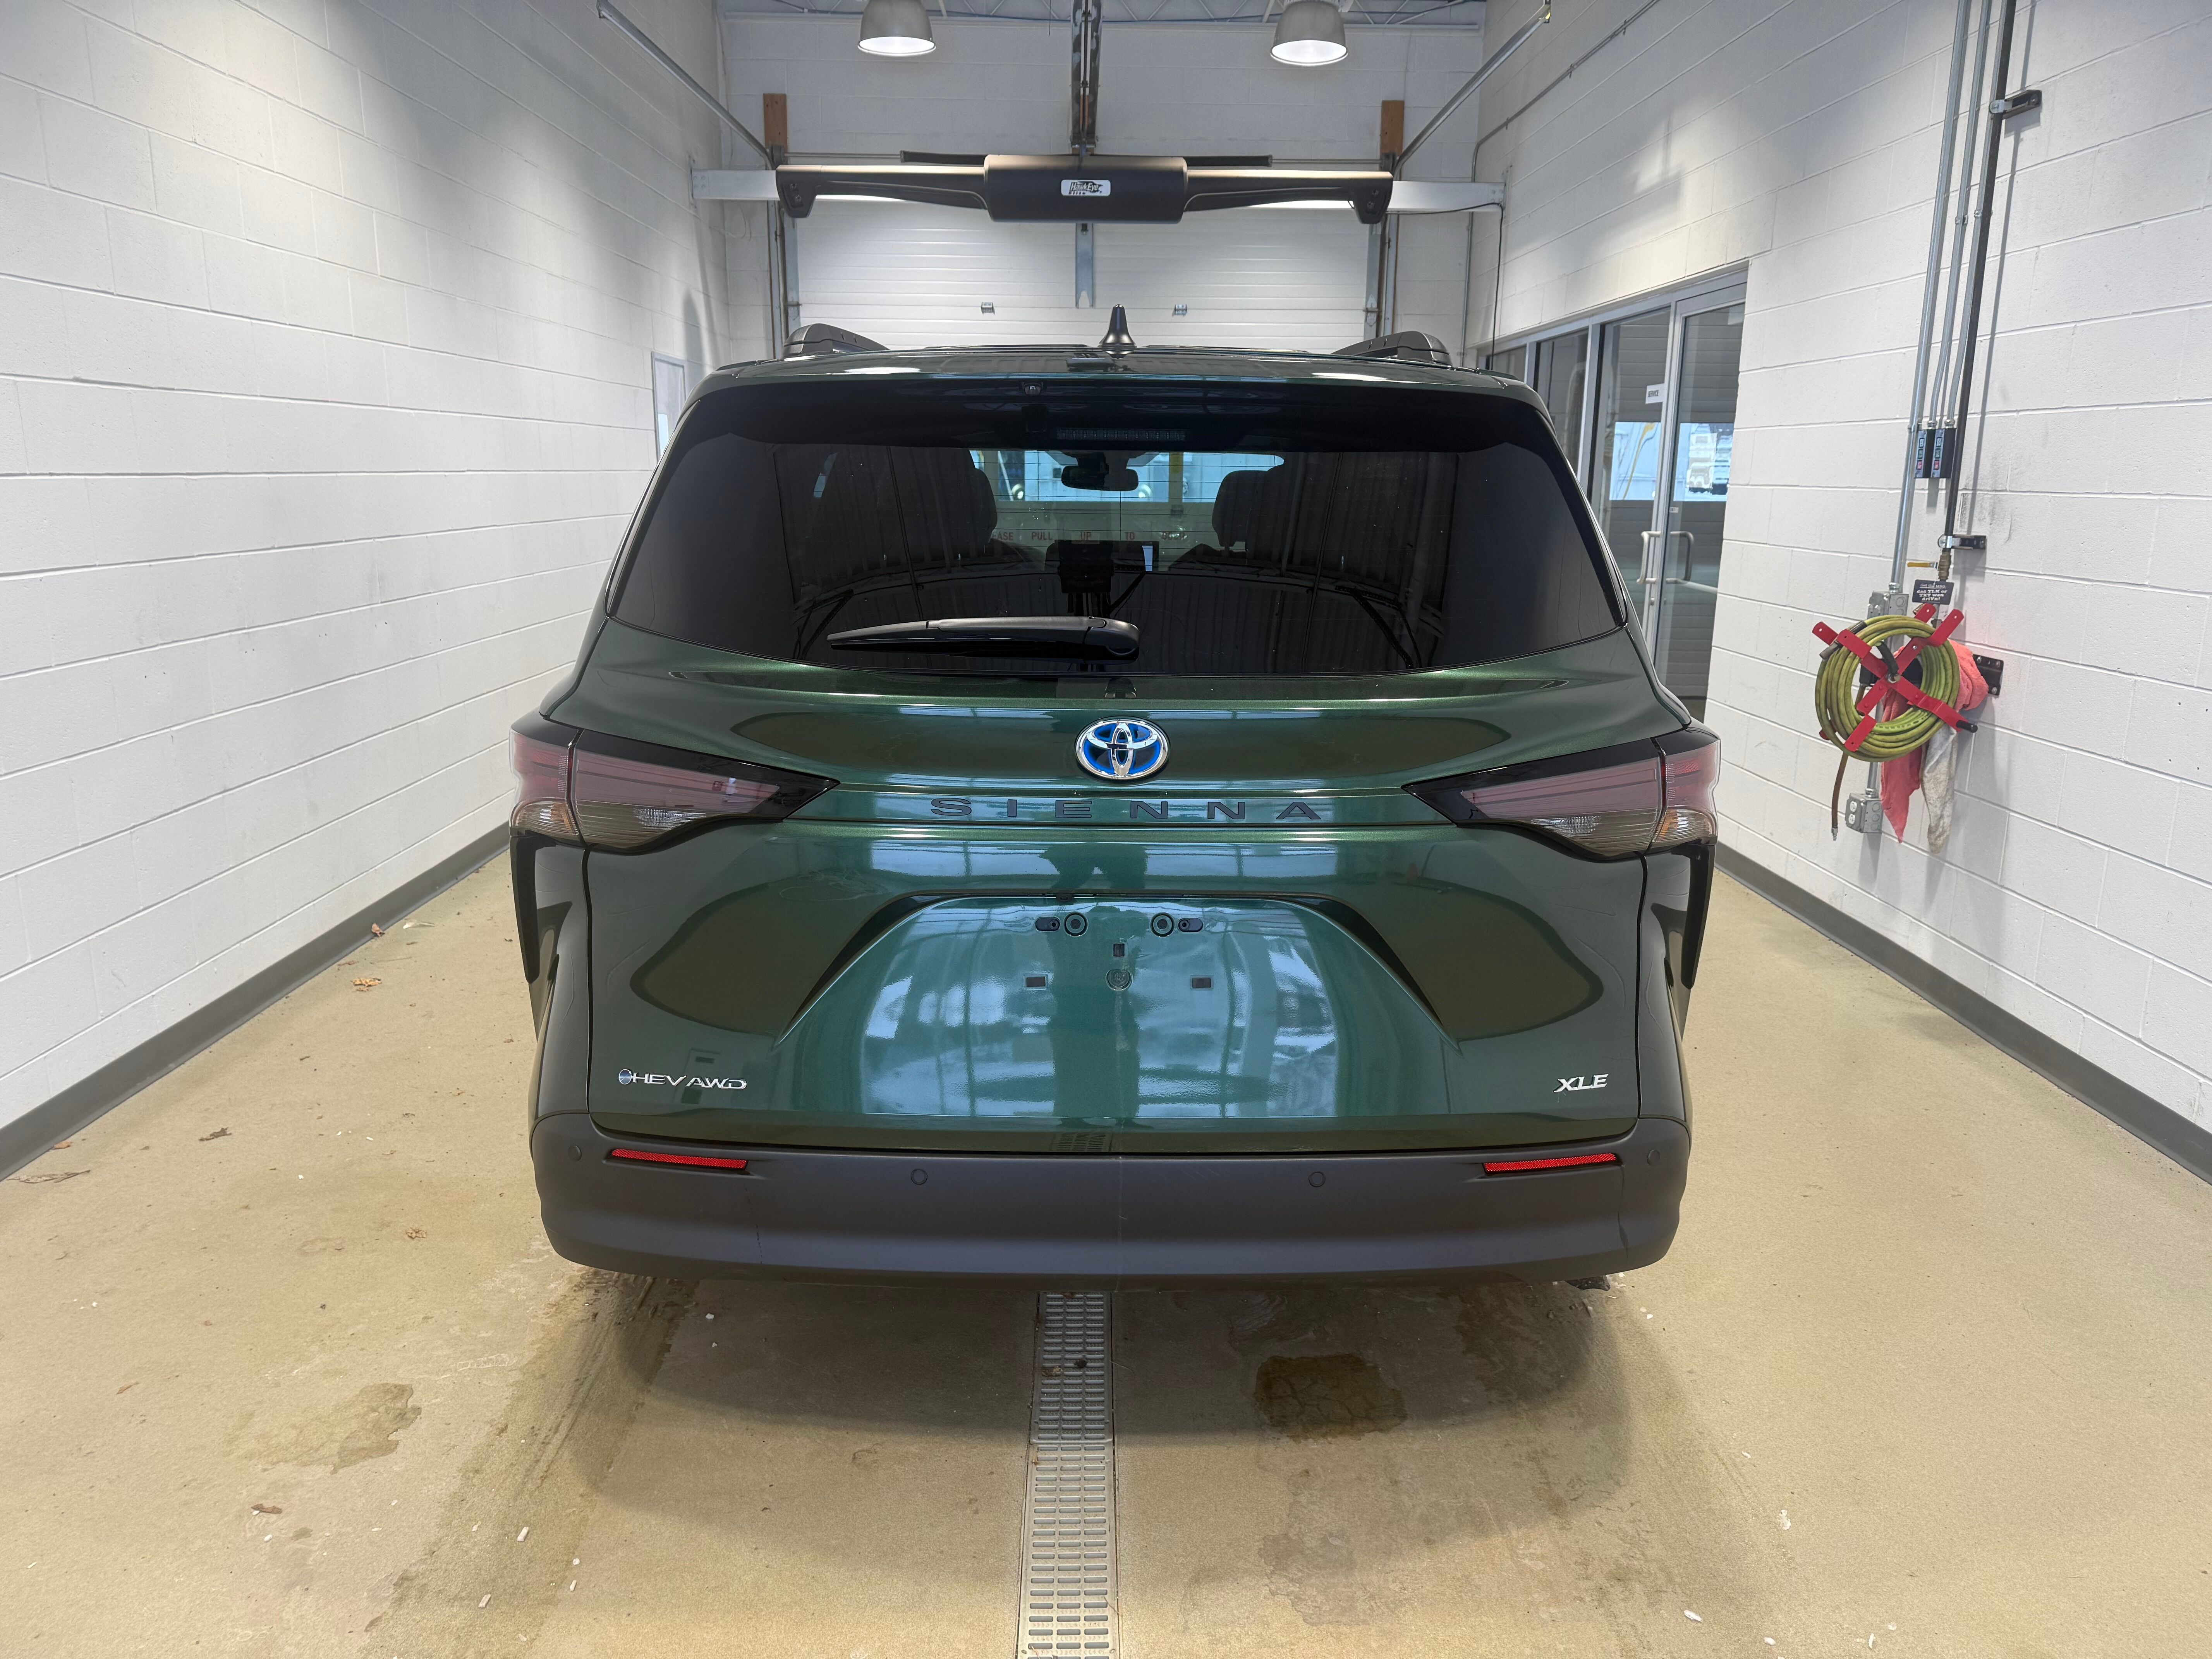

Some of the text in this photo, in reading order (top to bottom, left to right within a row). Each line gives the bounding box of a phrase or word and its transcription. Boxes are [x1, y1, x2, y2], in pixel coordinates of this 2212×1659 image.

[1070, 182, 1099, 192] HawkEye
[992, 532, 1014, 541] EASE
[1031, 531, 1053, 540] PULL
[1080, 531, 1092, 540] UP
[1124, 531, 1135, 540] TO
[930, 797, 1321, 820] SIENNA
[633, 1072, 748, 1090] HEV AWD
[1553, 1073, 1609, 1093] XLE
